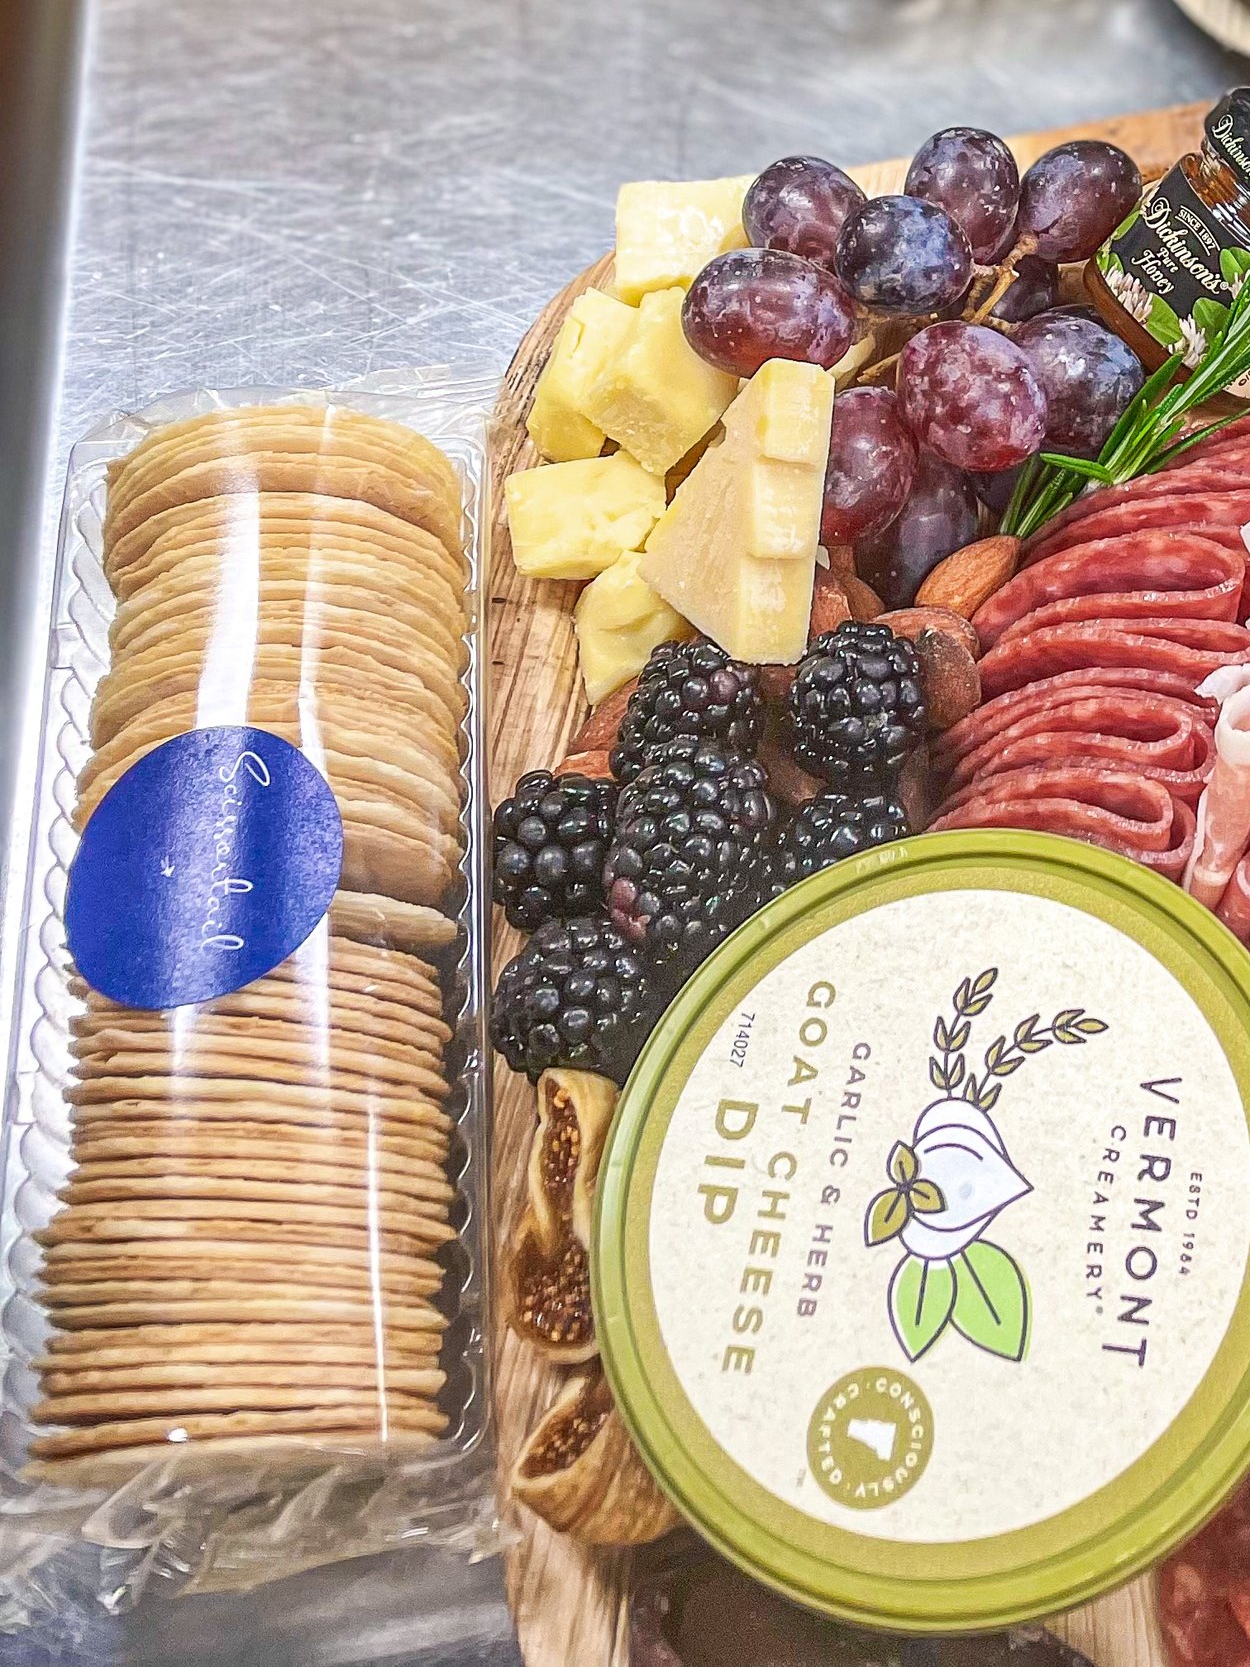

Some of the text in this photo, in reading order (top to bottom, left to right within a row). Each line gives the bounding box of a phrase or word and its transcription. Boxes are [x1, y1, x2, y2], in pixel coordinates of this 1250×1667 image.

[1131, 249, 1175, 295] Honey
[1156, 245, 1180, 273] Pure
[1178, 208, 1216, 250] SINCE 1897
[201, 751, 271, 953] Scissortail
[729, 1012, 756, 1069] 714027
[697, 1097, 759, 1225] DIP
[721, 980, 837, 1375] GOAT CHEESE
[797, 1042, 872, 1317] GARLIC & HERB
[1085, 1124, 1127, 1301] CREAMERY
[1101, 1077, 1183, 1368] VERMONT
[1178, 1171, 1203, 1276] ESTD 1984
[818, 1383, 860, 1485] CRAFTED
[855, 1376, 924, 1498] CONSCIOUSLY
